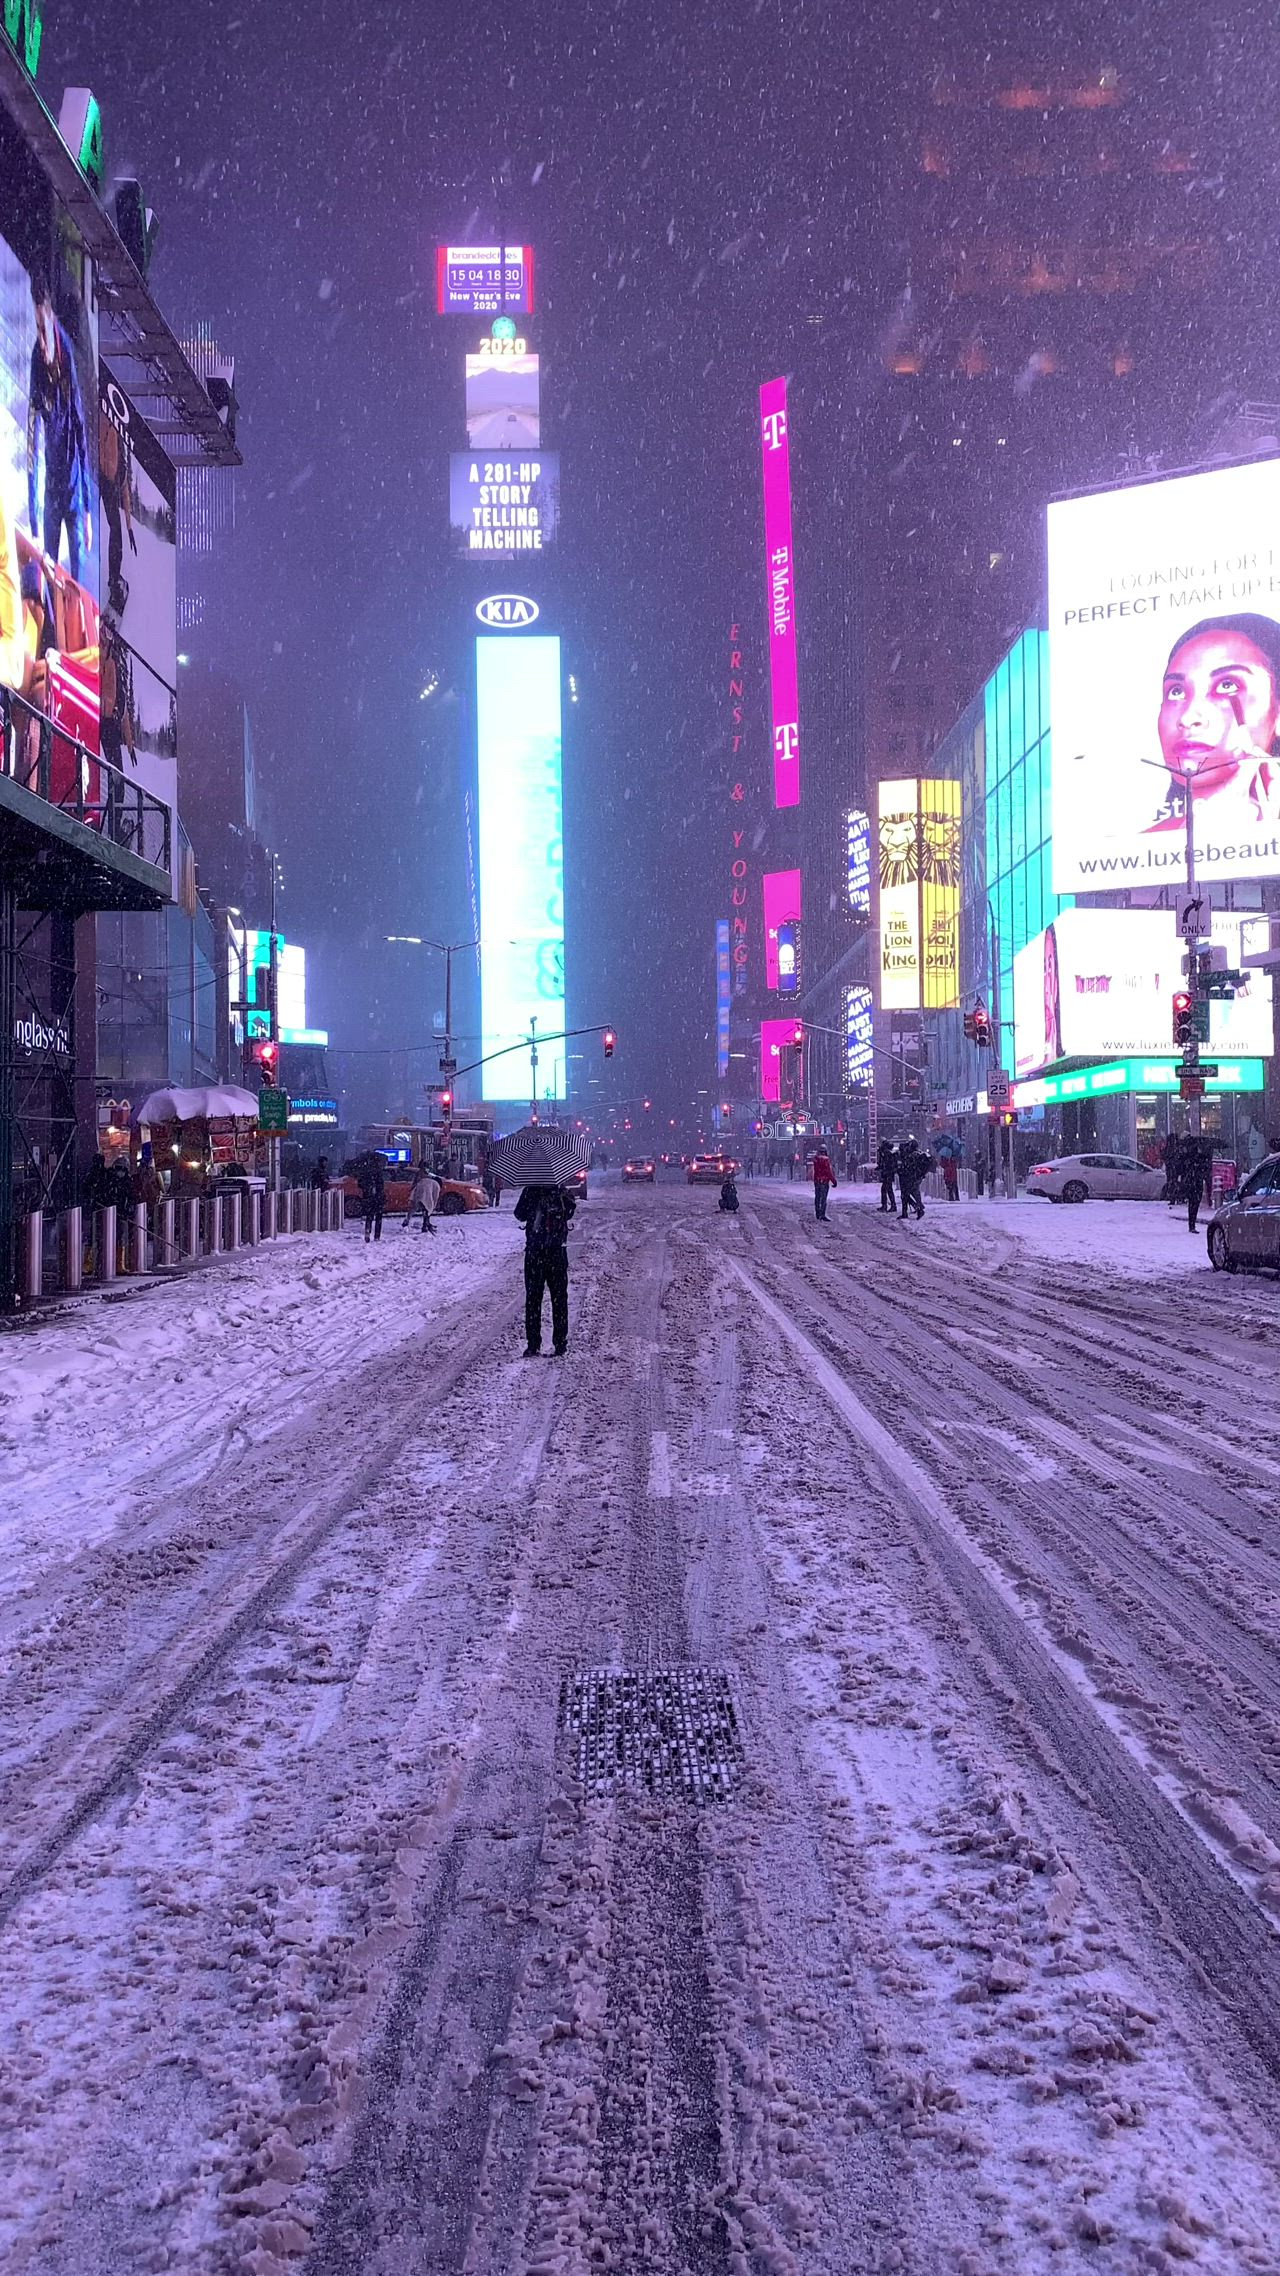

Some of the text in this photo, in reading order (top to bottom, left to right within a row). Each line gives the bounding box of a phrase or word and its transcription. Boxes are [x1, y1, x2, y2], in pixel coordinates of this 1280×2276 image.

[451, 270, 520, 281] 15 04 18 30
[449, 291, 521, 301] New Year's Eve
[473, 301, 498, 310] 2020
[479, 338, 526, 354] 2020
[102, 398, 135, 451] OAKLEY
[469, 463, 541, 483] A 281-HP
[479, 485, 531, 505] STORY
[472, 507, 538, 527] TELLING
[469, 530, 542, 549] MACHINE
[487, 601, 529, 621] KIA
[1064, 595, 1161, 626] PERFECT
[729, 624, 743, 752] ERNST
[731, 831, 747, 963] YOUNG
[887, 921, 908, 931] THE
[1181, 925, 1206, 934] ONLY
[884, 934, 912, 949] LION
[883, 952, 917, 970] KING
[990, 1085, 1007, 1095] 25
